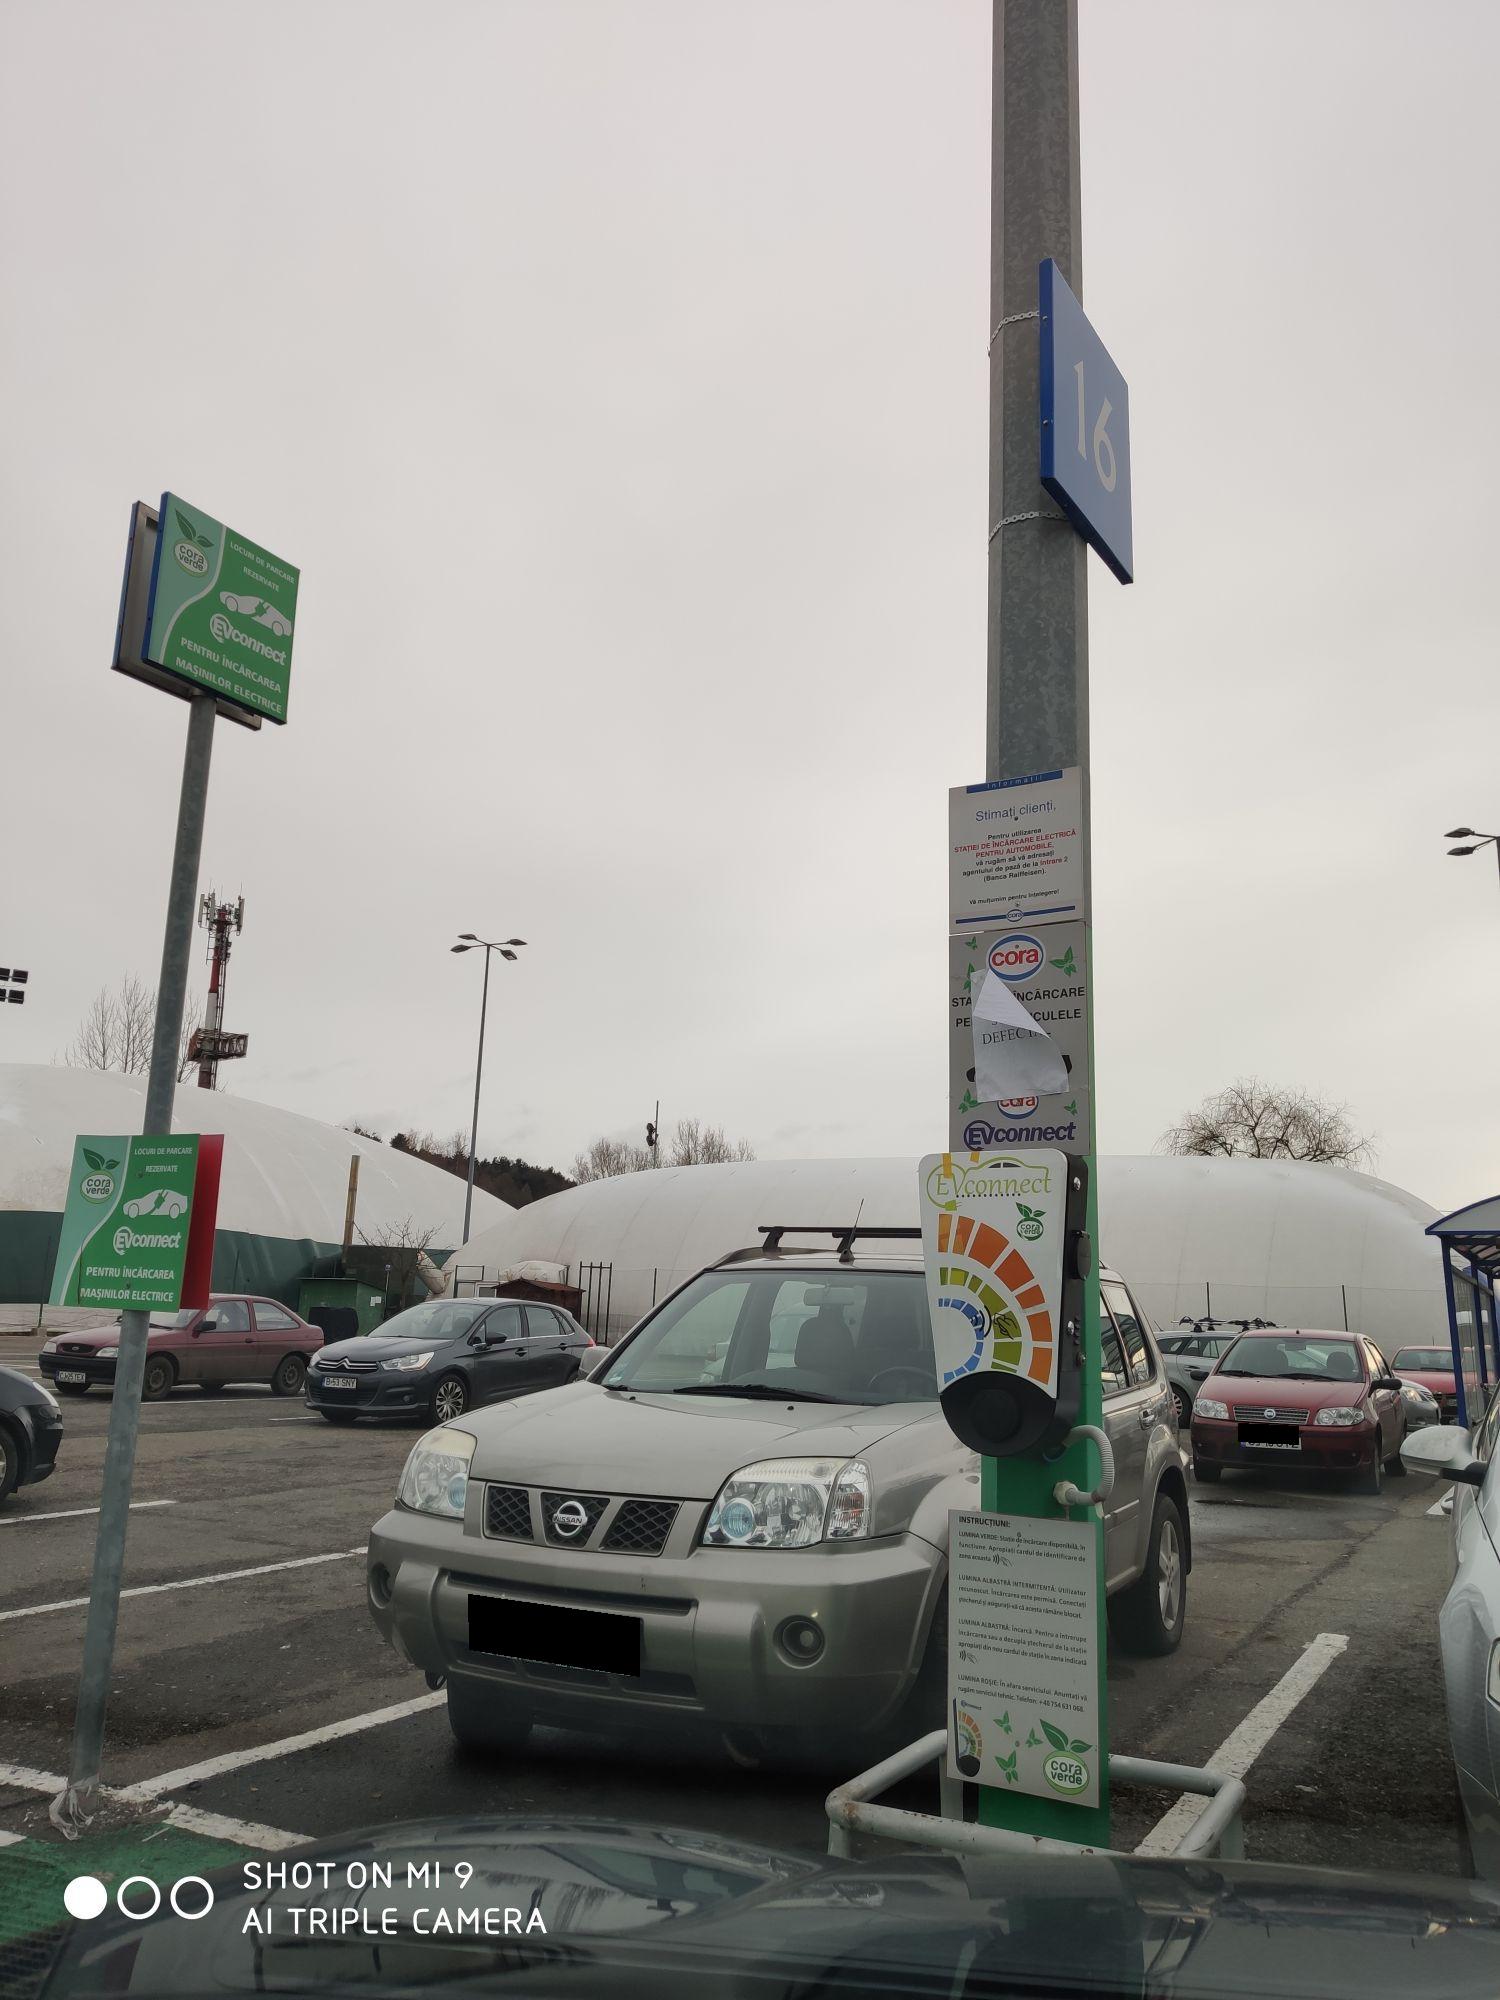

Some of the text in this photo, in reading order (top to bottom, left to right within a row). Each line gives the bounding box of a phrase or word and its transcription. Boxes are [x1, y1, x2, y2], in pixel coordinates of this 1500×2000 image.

[1073, 360, 1116, 492] 16
[179, 545, 205, 565] cora
[256, 557, 265, 567] DE
[178, 554, 205, 572] verde
[210, 614, 286, 666] EVconnect
[180, 637, 219, 662] PENTRU
[234, 684, 282, 714] ELECTRICE
[1012, 828, 1042, 836] utilizarea
[976, 850, 1004, 858] PENTRU
[962, 867, 993, 876] agentului
[992, 948, 1038, 966] cora
[965, 1121, 1076, 1147] EVconnect
[146, 1164, 178, 1172] REZERVATE
[86, 1177, 110, 1186] cora
[936, 1173, 1052, 1196] EVconnect
[86, 1186, 110, 1194] verde
[114, 1229, 181, 1250] EVconnect
[86, 1266, 120, 1278] PENTRU
[132, 1290, 174, 1302] ELECTRICE
[958, 1574, 981, 1582] LUMINA
[958, 1674, 980, 1682] LUMINA
[1050, 1760, 1082, 1776] cora
[1050, 1770, 1082, 1784] verde
